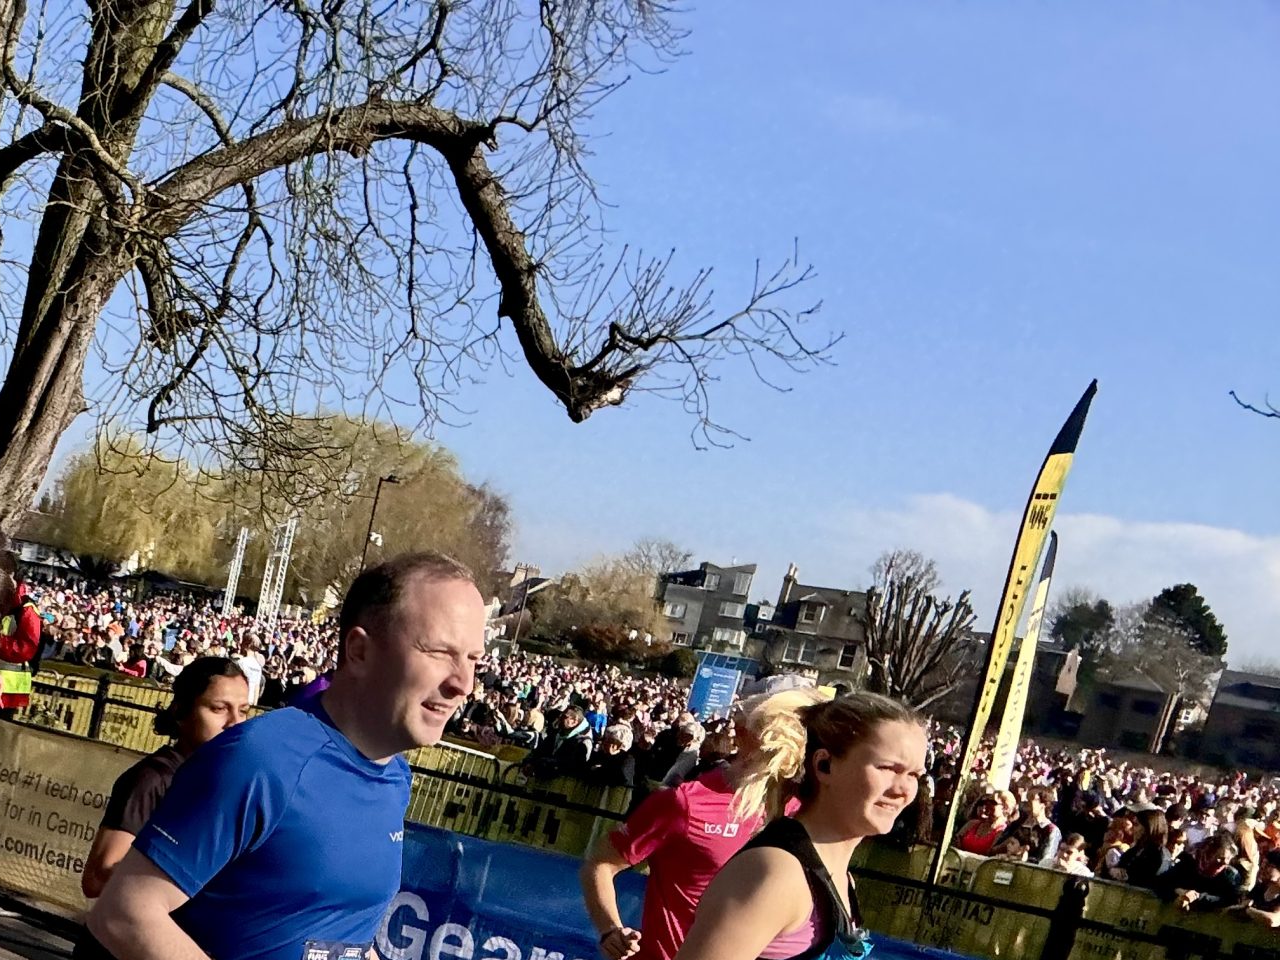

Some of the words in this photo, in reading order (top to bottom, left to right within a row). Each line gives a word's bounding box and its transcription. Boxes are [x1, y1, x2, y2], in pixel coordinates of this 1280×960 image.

[21, 770, 42, 792] #1
[45, 776, 79, 803] tech
[3, 800, 26, 821] for
[27, 804, 42, 828] in
